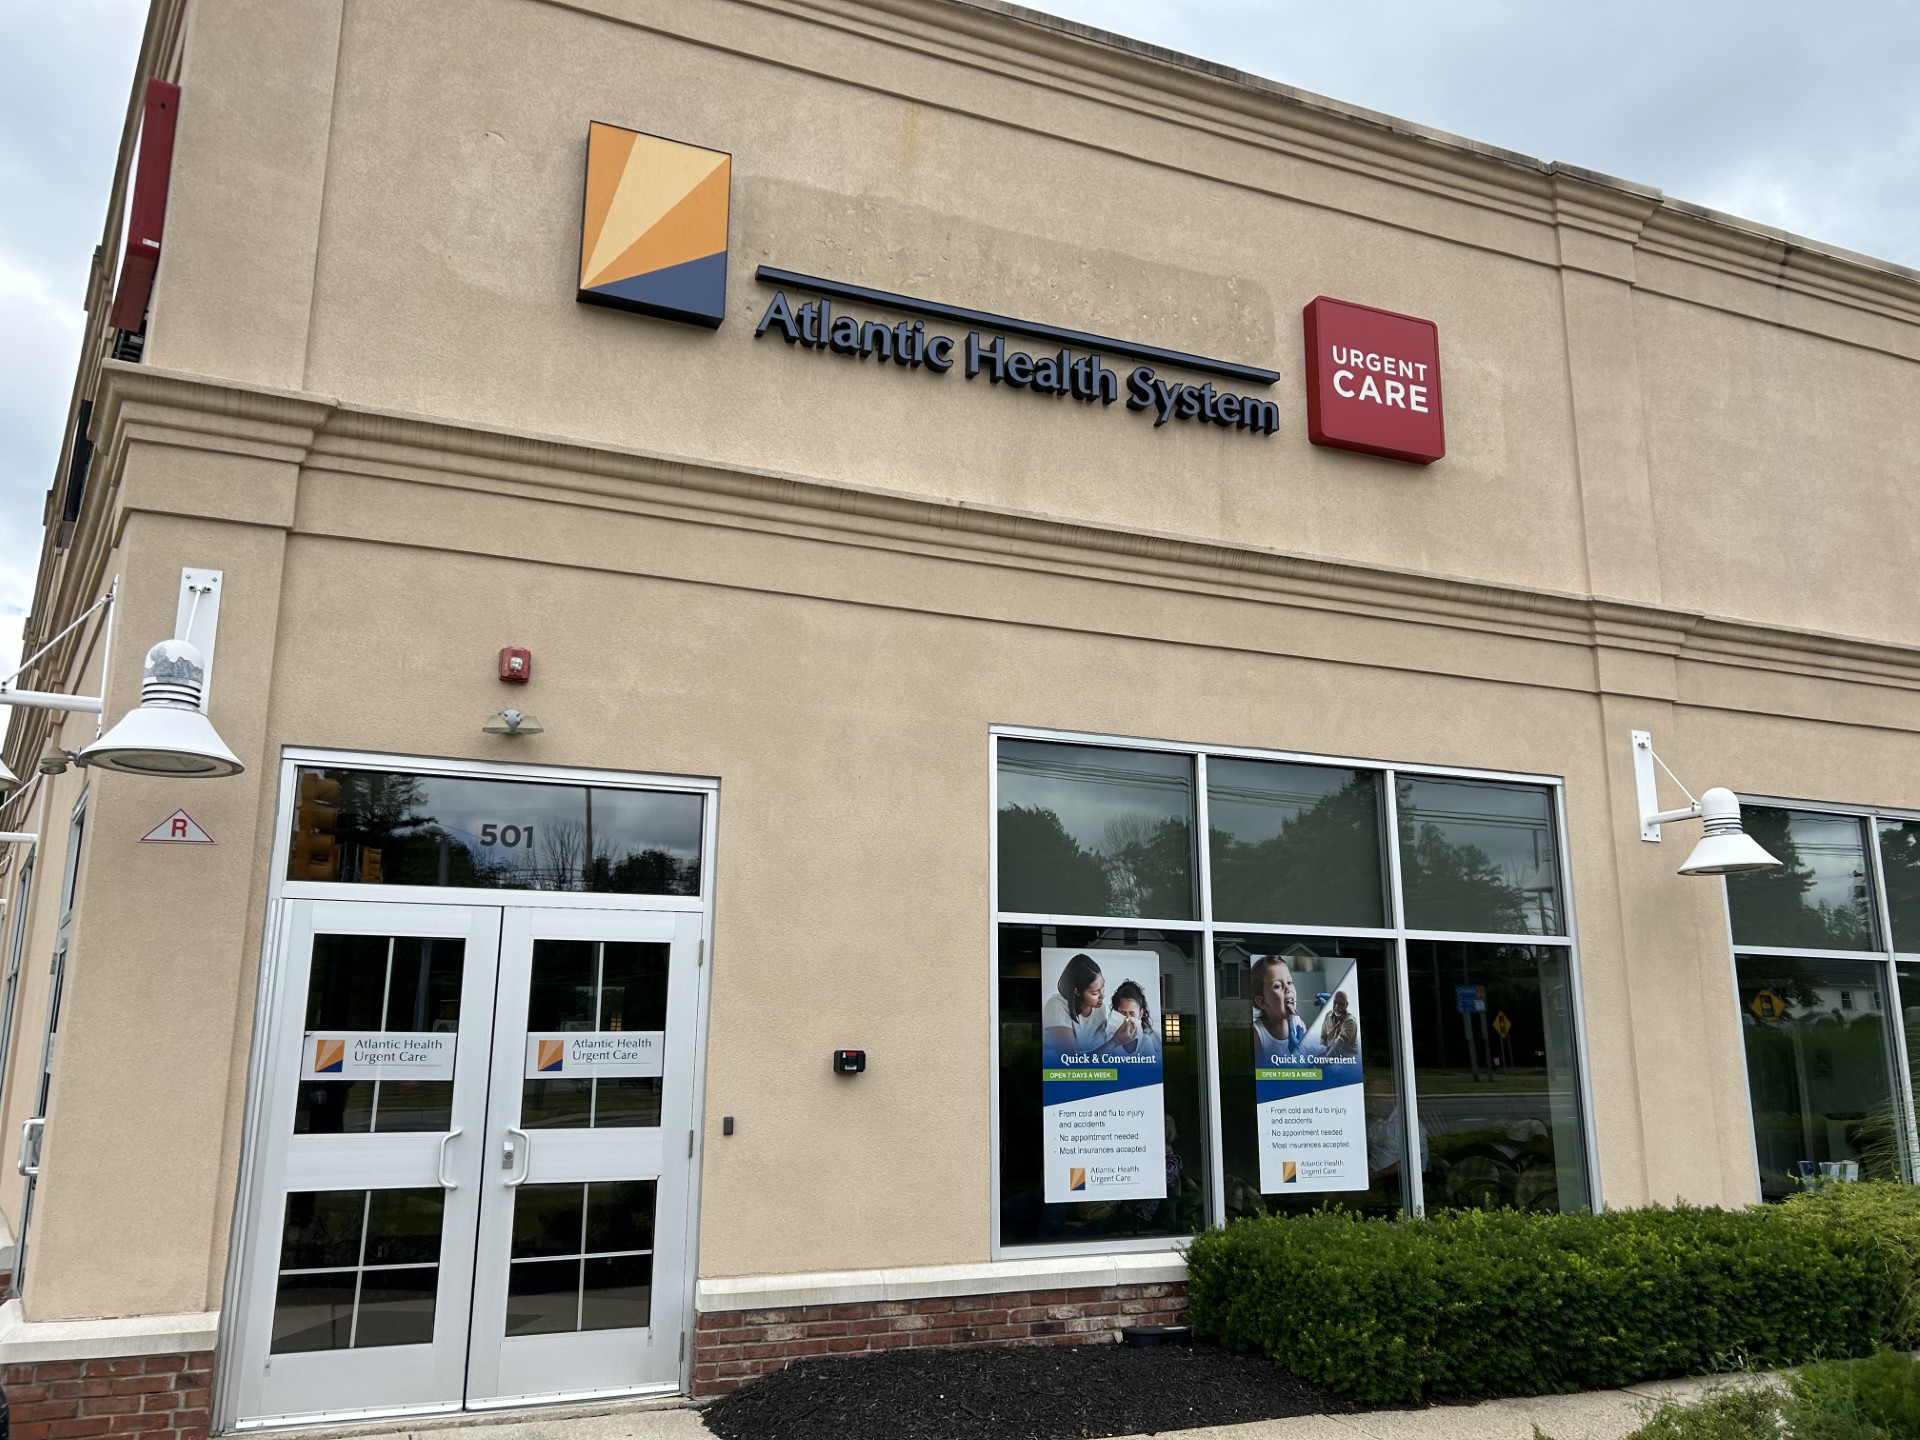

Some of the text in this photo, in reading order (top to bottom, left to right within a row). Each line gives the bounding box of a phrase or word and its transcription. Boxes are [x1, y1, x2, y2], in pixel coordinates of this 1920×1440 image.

[755, 291, 1279, 436] Atlantic Health System
[1332, 345, 1427, 381] URGENT
[1333, 369, 1429, 413] CARE
[171, 818, 188, 838] R
[479, 823, 535, 850] 501
[354, 1039, 443, 1050] Atlantic Health
[572, 1038, 652, 1049] Atlantic Health
[354, 1051, 427, 1065] Urgent Care
[572, 1050, 638, 1063] Urgent Care
[1060, 1053, 1157, 1066] Quick & Convenient
[1270, 1054, 1357, 1066] Quick & Convenient
[1058, 1109, 1145, 1118] From cold and flu to injury
[1270, 1106, 1347, 1115] From cold and flu to injury
[1073, 1120, 1106, 1128] accidents
[1271, 1117, 1313, 1125] and accidents
[1059, 1132, 1139, 1143] No appointment needed
[1271, 1129, 1281, 1137] No
[1282, 1129, 1319, 1138] appointment
[1059, 1145, 1147, 1155] Most insurances accepted
[1322, 1141, 1350, 1149] accepted
[1325, 1159, 1344, 1167] Health
[1090, 1165, 1140, 1174] Atlantic Health
[1090, 1174, 1132, 1184] Urgent Care
